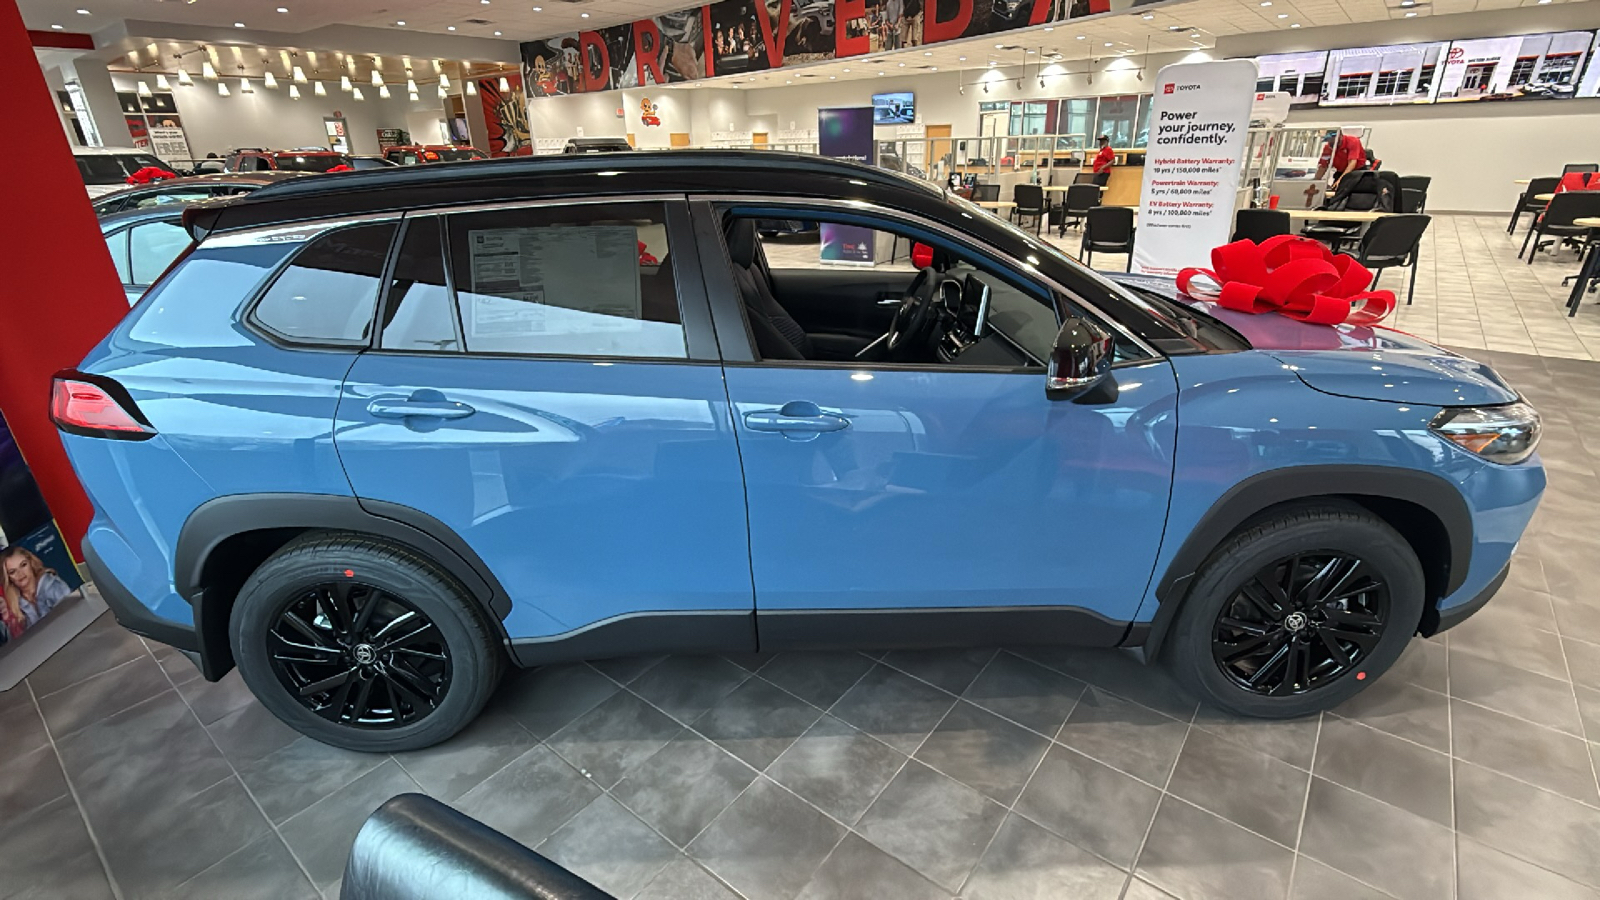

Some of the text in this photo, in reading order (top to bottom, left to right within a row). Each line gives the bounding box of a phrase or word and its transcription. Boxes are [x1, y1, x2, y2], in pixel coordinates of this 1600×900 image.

[1160, 111, 1198, 121] Power
[1158, 122, 1235, 136] your journey,
[1157, 133, 1228, 145] confidently.
